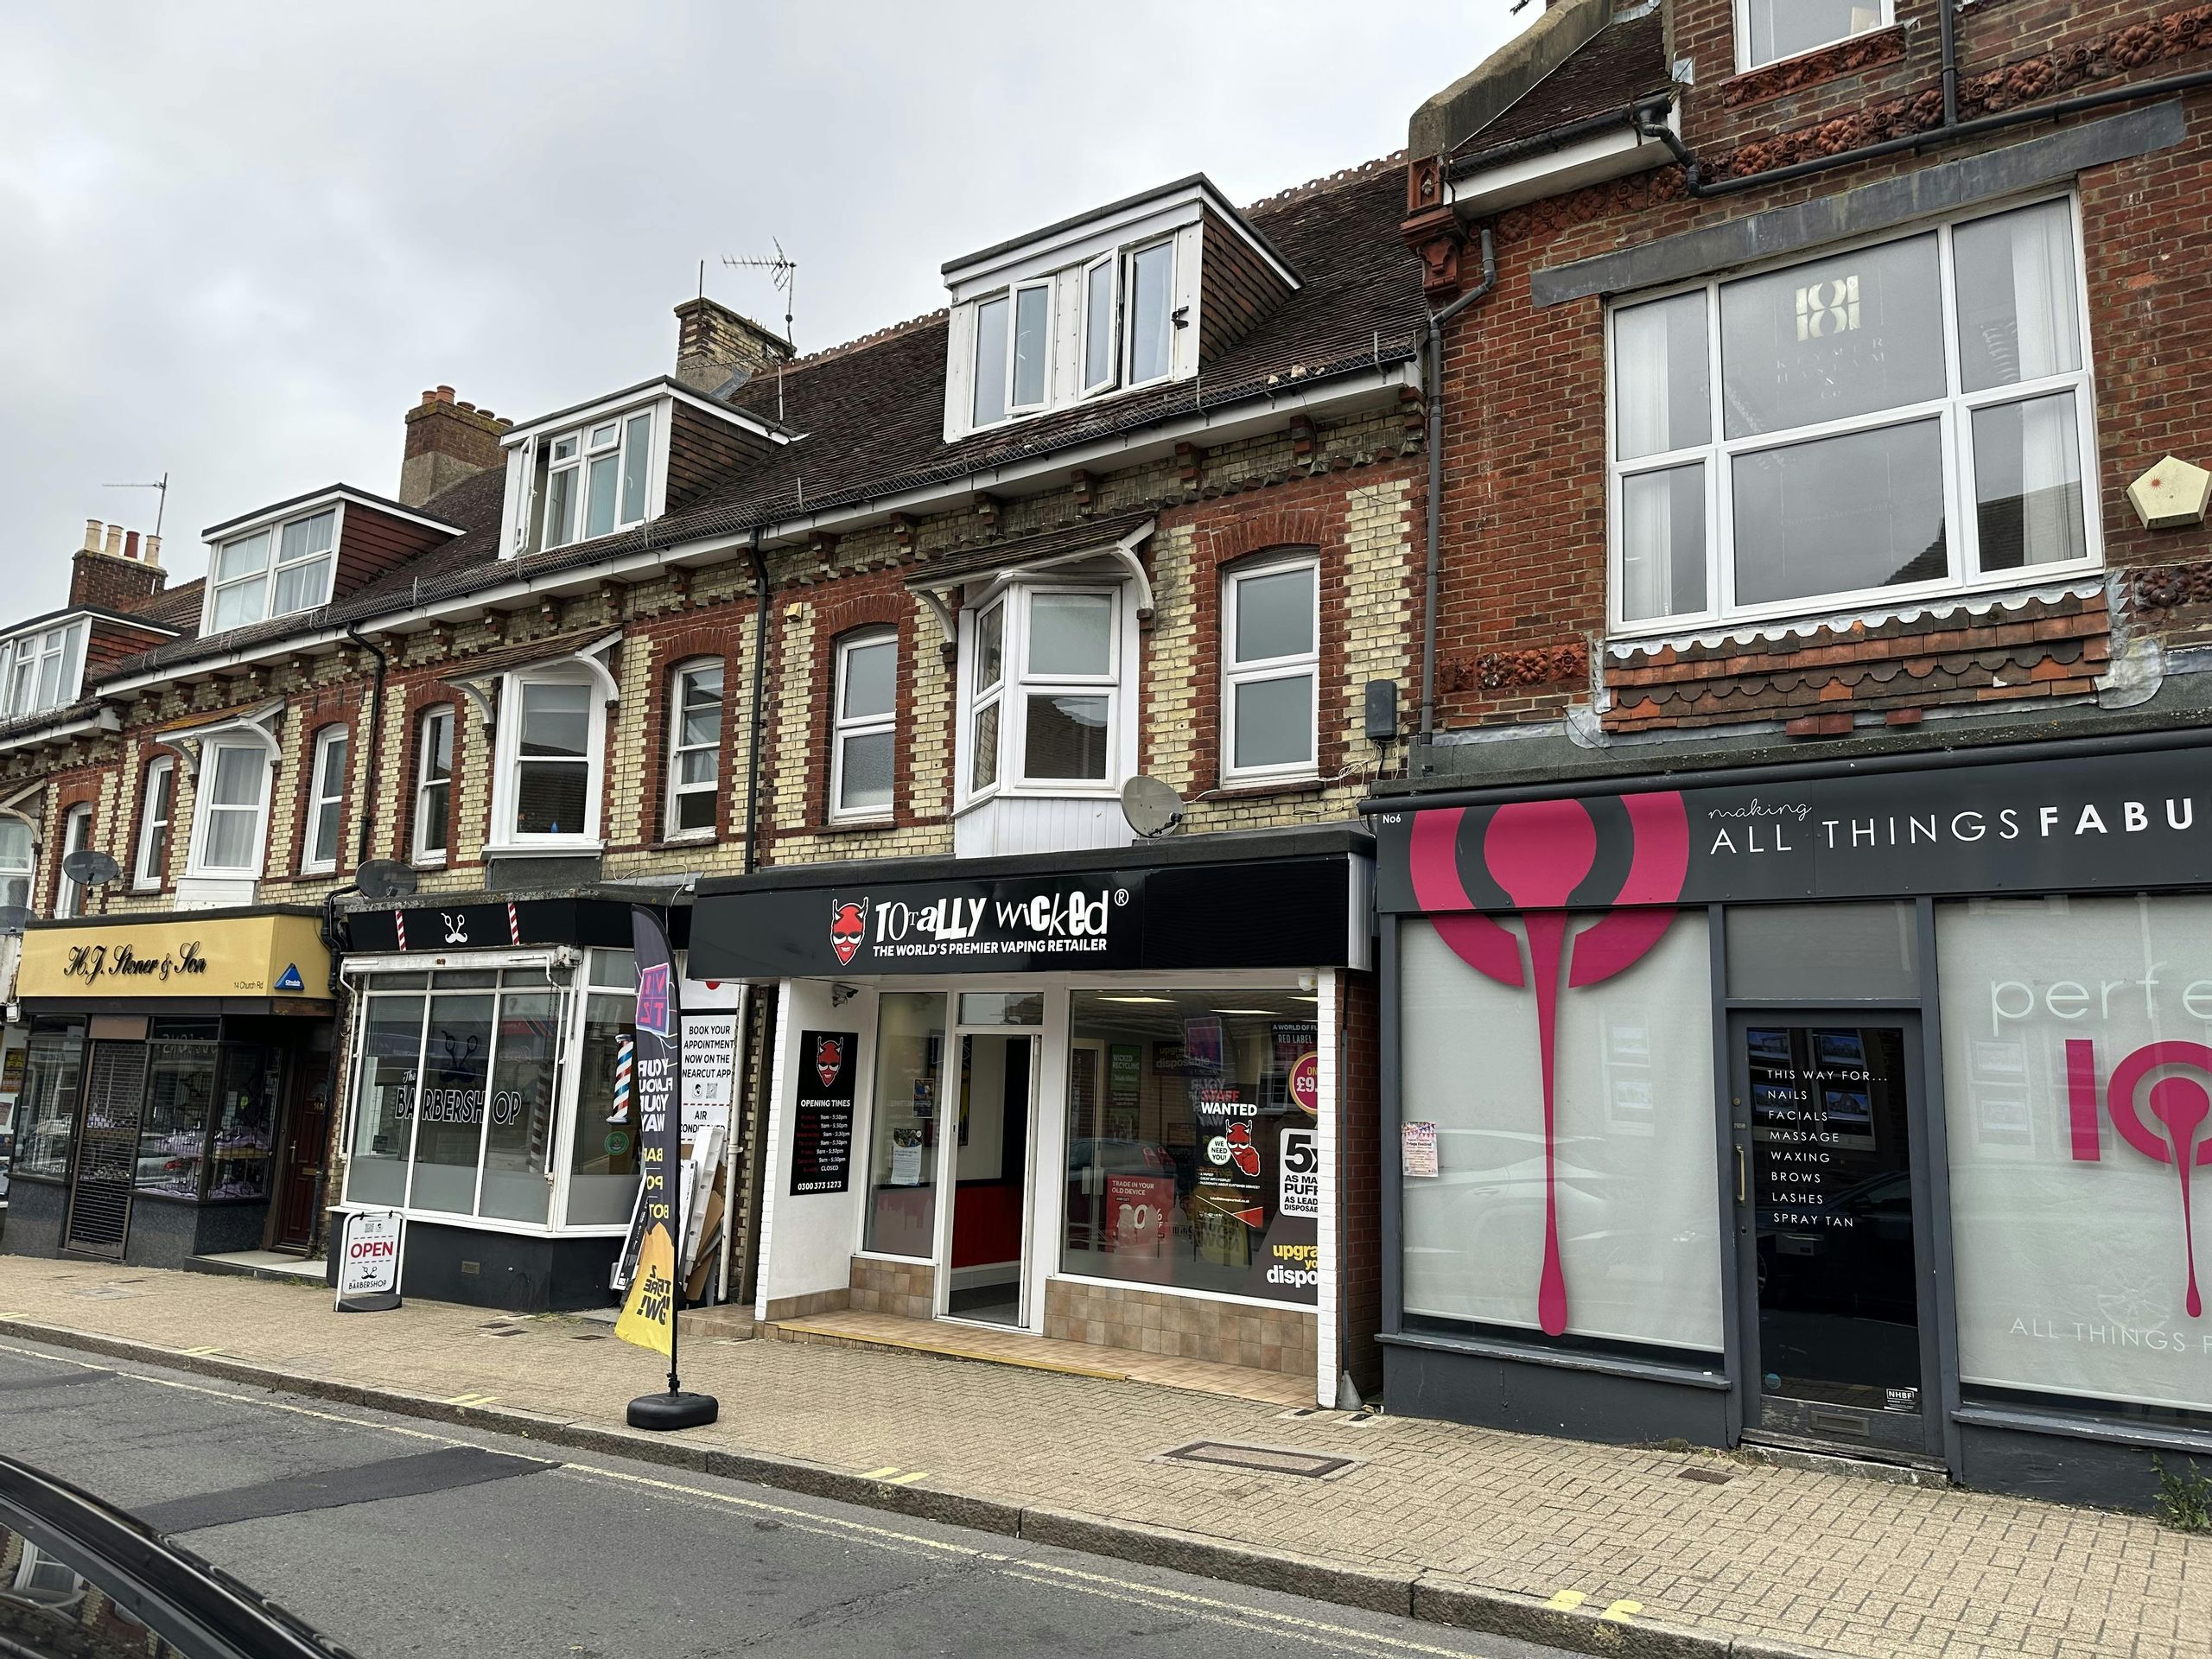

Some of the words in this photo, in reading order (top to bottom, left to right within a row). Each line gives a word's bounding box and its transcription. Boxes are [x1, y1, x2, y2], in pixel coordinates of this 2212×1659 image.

[1707, 798, 1813, 822] making
[1382, 814, 1402, 824] No6
[1710, 823, 1793, 855] ALL
[1821, 809, 2020, 849] THINGS
[2038, 798, 2194, 838] FABU
[873, 945, 894, 957] THE
[896, 943, 948, 957] WORLD'S
[949, 941, 999, 955] PREMIER
[1001, 940, 1046, 953] VAPING
[1047, 938, 1107, 952] RETAILER
[108, 943, 160, 976] Stoner
[158, 952, 174, 982] &
[174, 941, 207, 975] Son
[239, 981, 256, 989] Church
[256, 981, 264, 989] Rd
[1991, 960, 2212, 1037] perfe
[689, 1026, 709, 1035] BOOK
[710, 1025, 731, 1035] YOUR
[683, 1039, 734, 1050] APPOINTMENT
[1278, 1034, 1291, 1044] RED
[1293, 1034, 1313, 1044] LABEL
[684, 1054, 703, 1064] NOW
[703, 1054, 715, 1064] ON
[716, 1054, 730, 1064] THE
[402, 1069, 416, 1084] The
[682, 1069, 715, 1078] NEARCUT
[716, 1069, 732, 1078] APP
[1306, 1066, 1318, 1077] ON
[1767, 1070, 1796, 1079] THIS
[1803, 1071, 1834, 1080] WAY
[1841, 1071, 1887, 1081] FOR...
[1200, 1089, 1241, 1103] STAFF
[1768, 1090, 1808, 1100] NAILS
[395, 1087, 522, 1125] BARBERSHOP
[800, 1099, 830, 1108] OPENING
[831, 1099, 851, 1108] TIMES
[1200, 1102, 1258, 1116] WANTED
[694, 1110, 708, 1120] AIR
[1769, 1110, 1827, 1122] FACIALS
[1770, 1131, 1839, 1142] MASSAGE
[1770, 1151, 1830, 1163] WAXING
[1285, 1174, 1299, 1183] AS
[1771, 1171, 1821, 1183] BROWS
[827, 1180, 842, 1189] 1273
[1298, 1197, 1318, 1205] LEAD
[1772, 1192, 1823, 1205] LASHES
[1773, 1213, 1818, 1225] SPRAY
[1826, 1216, 1853, 1227] TAN
[350, 1241, 394, 1258] OPEN
[1272, 1244, 1318, 1261] upgra
[1305, 1259, 1318, 1271] yo
[1267, 1265, 1318, 1288] dispo
[348, 1280, 387, 1290] BARBERSHOP
[2009, 1317, 2060, 1338] ALL
[2074, 1322, 2185, 1352] THINGS
[2203, 1335, 2212, 1354] F
[1888, 1390, 1912, 1399] NHBF
